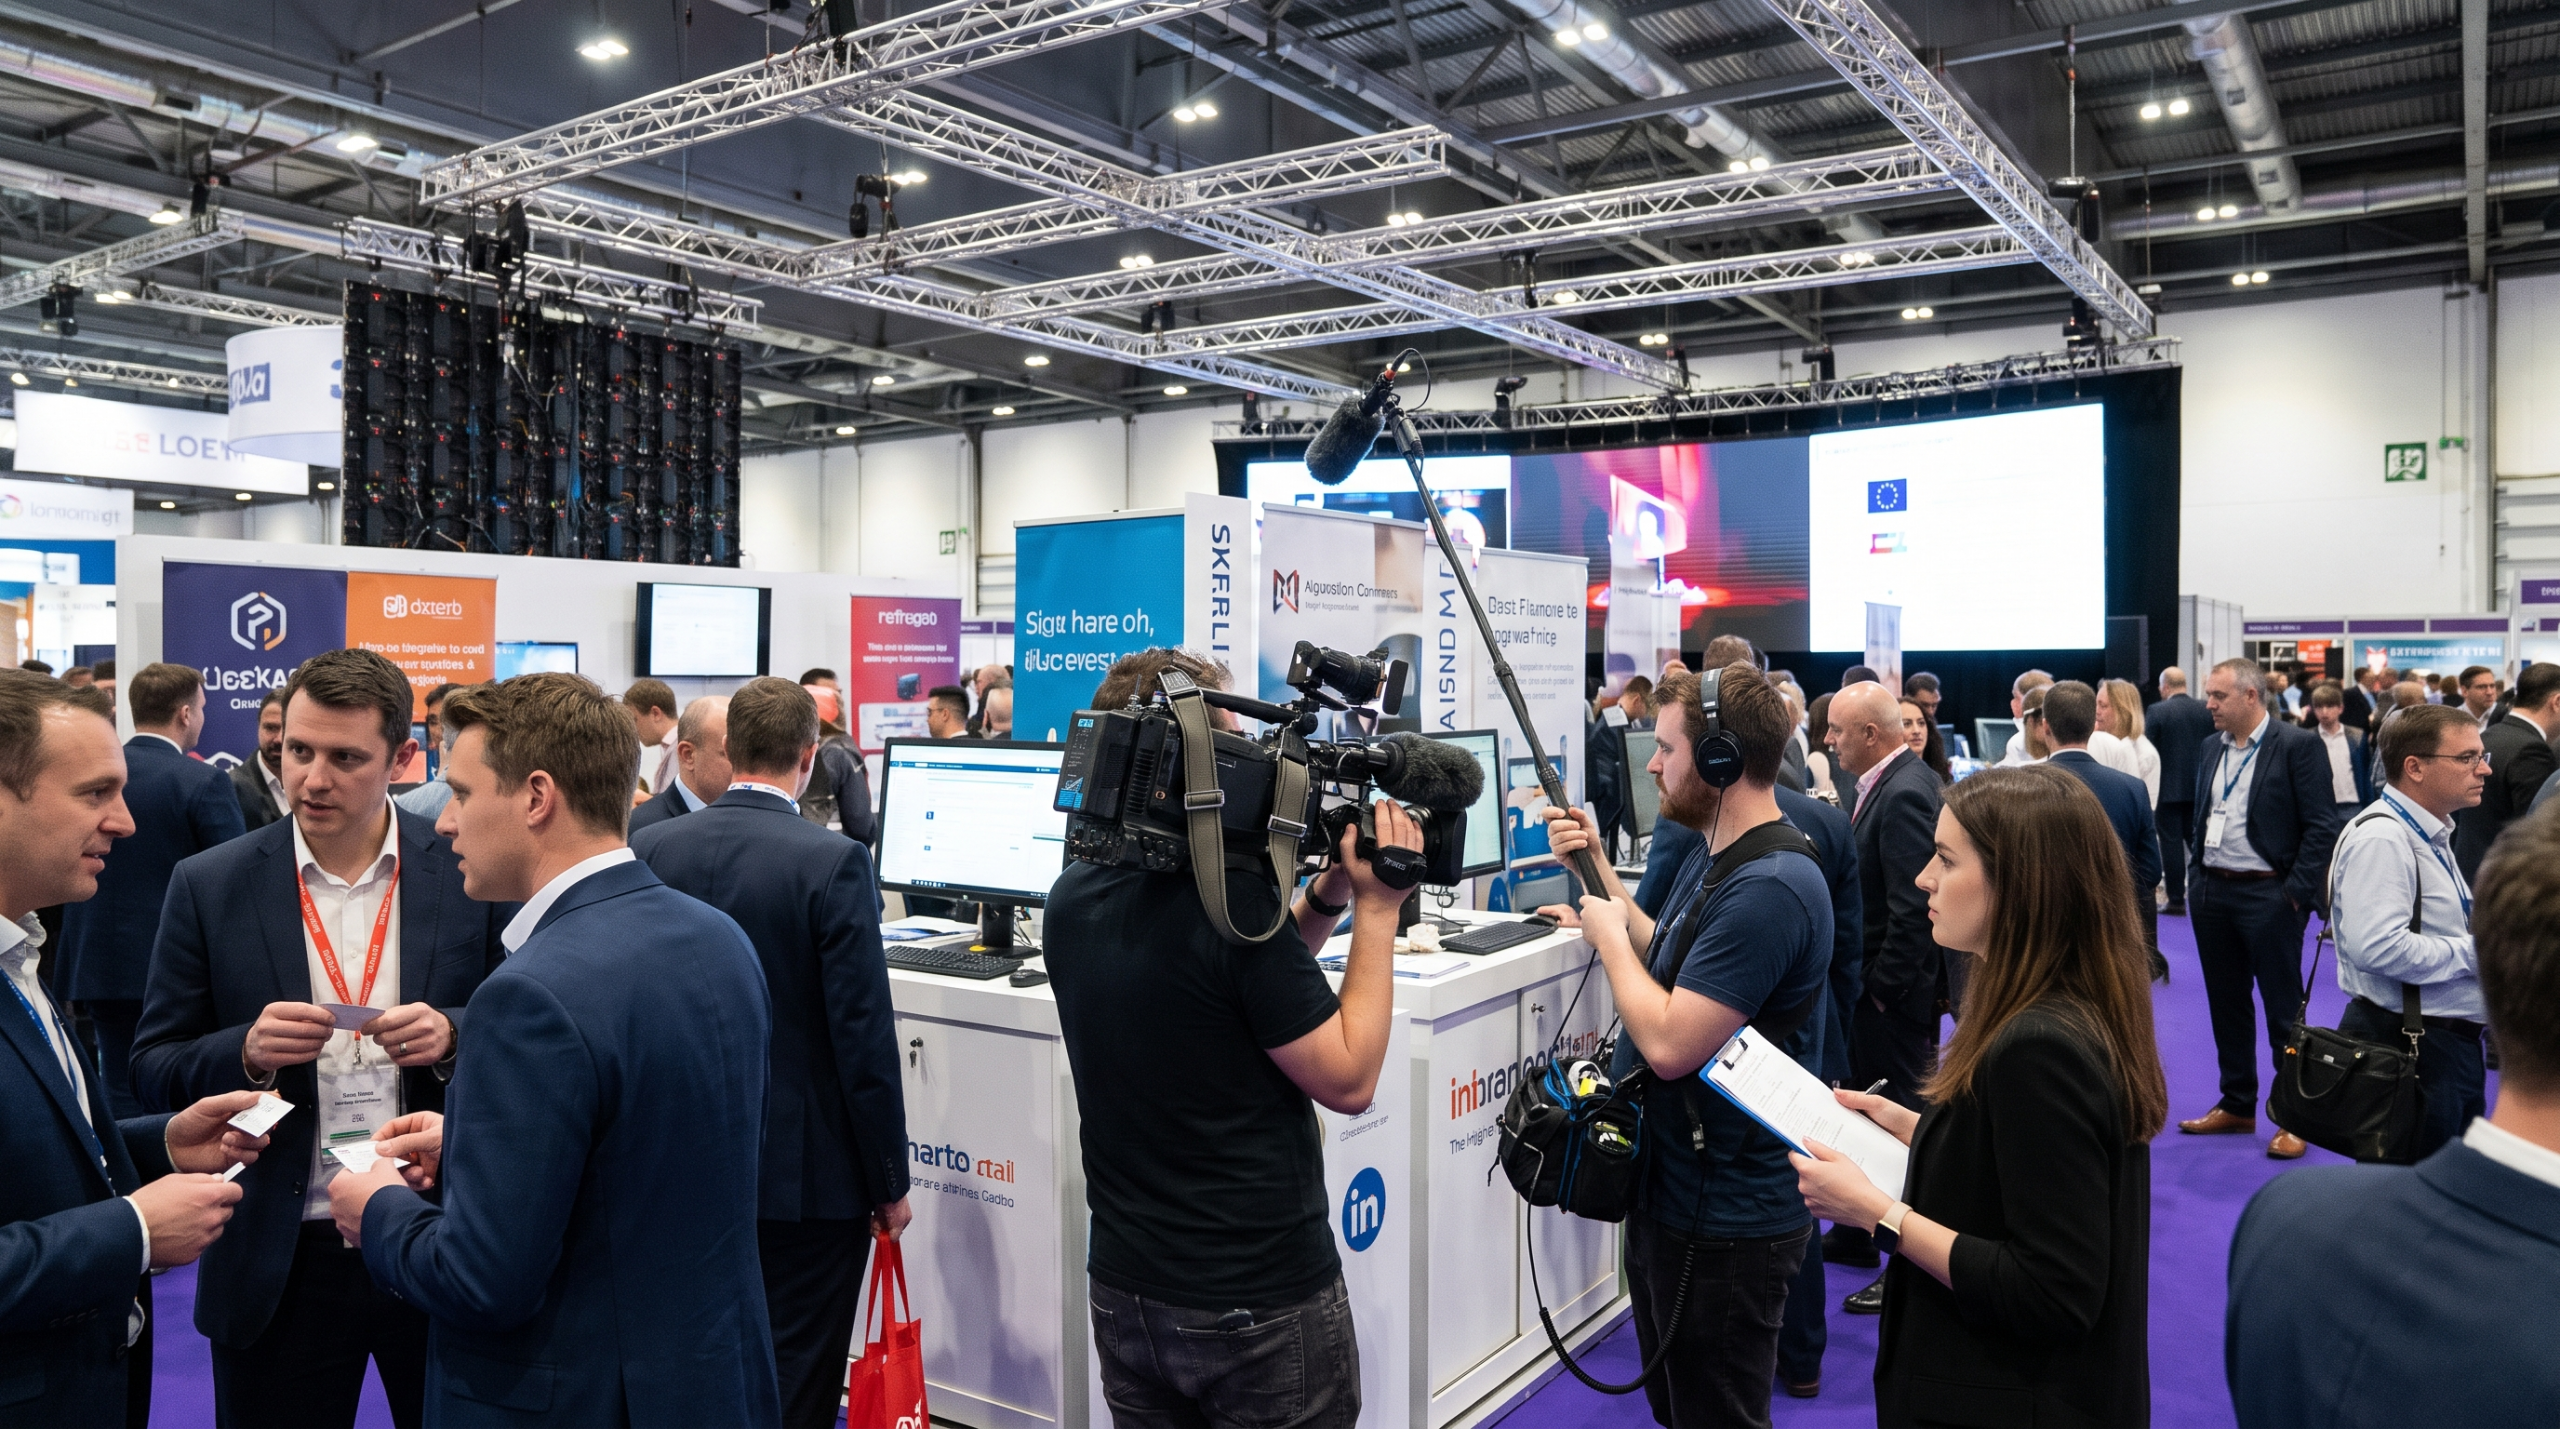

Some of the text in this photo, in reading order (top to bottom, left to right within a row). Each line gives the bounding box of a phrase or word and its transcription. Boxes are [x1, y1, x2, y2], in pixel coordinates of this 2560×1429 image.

[1071, 609, 1119, 634] hare
[1121, 607, 1155, 637] oh,
[1350, 1188, 1379, 1239] in
